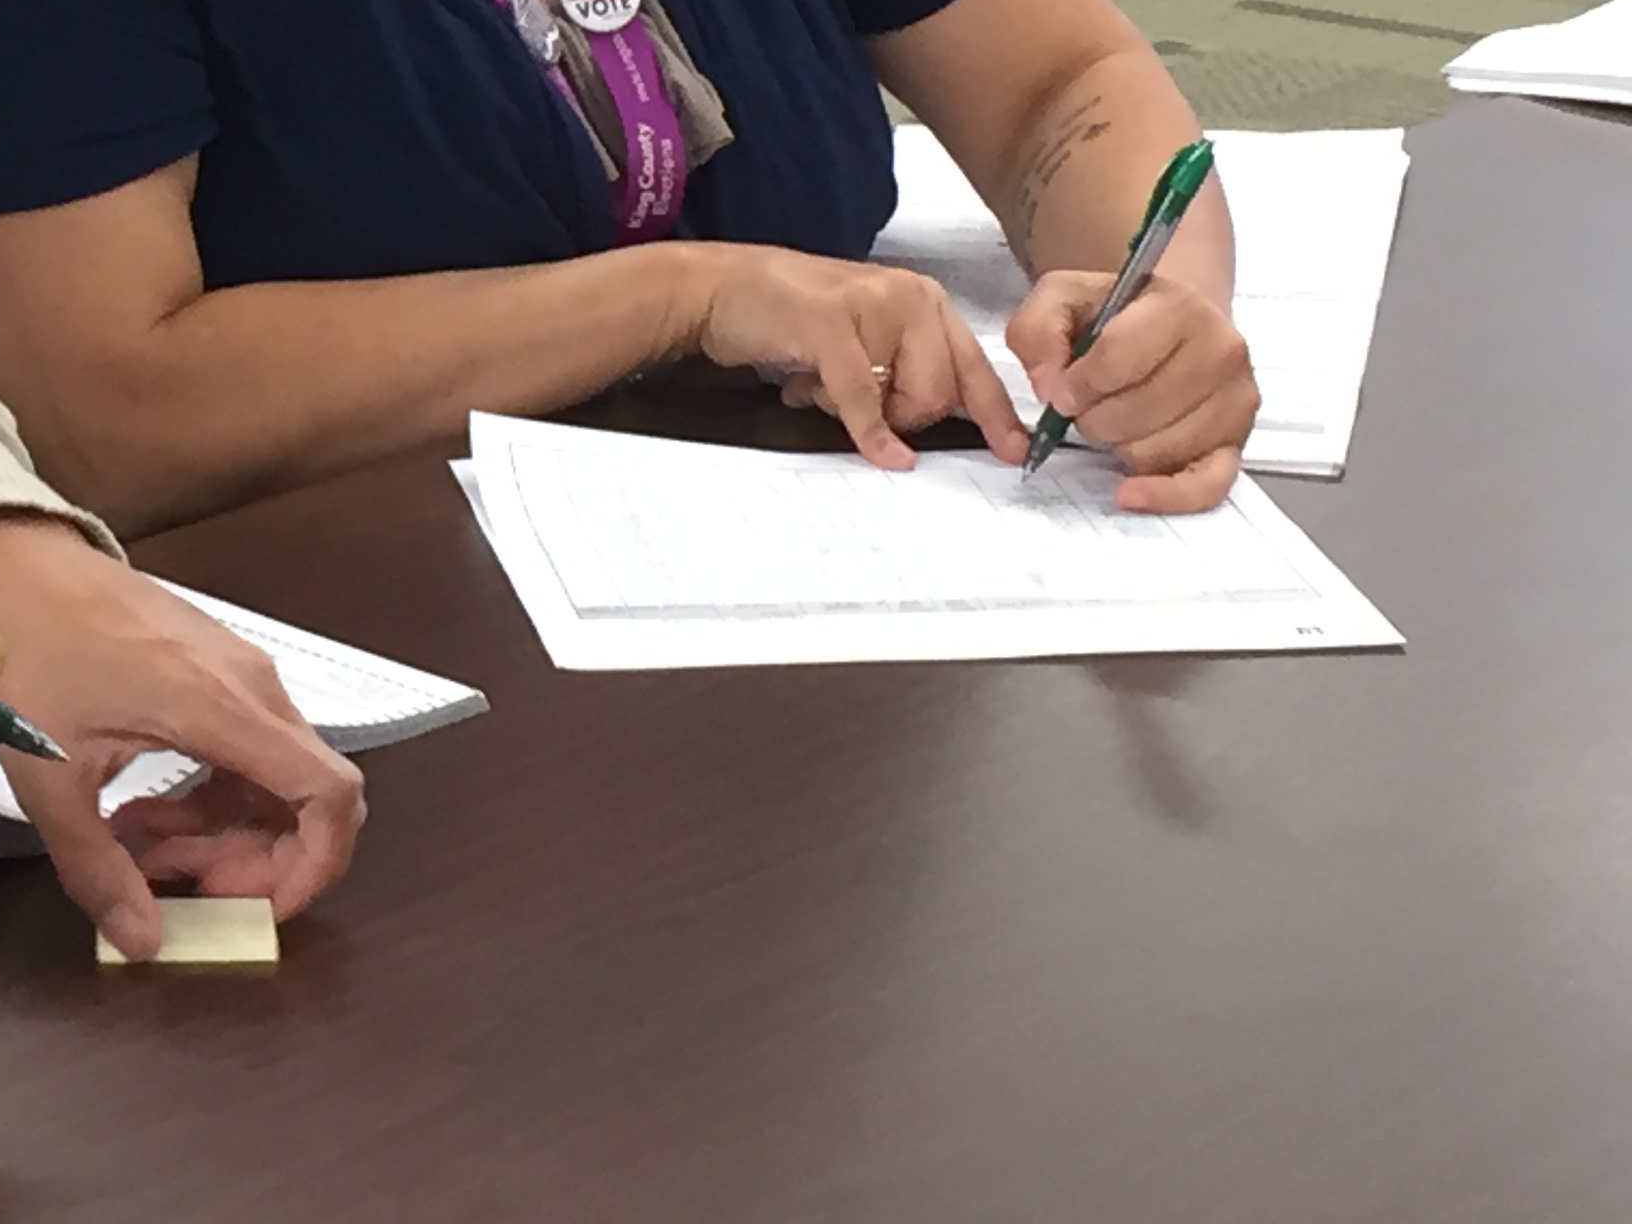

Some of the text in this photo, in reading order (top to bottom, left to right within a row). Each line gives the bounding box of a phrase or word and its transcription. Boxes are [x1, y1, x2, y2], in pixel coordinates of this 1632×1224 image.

[627, 122, 656, 229] King County
[652, 137, 674, 216] Elections
